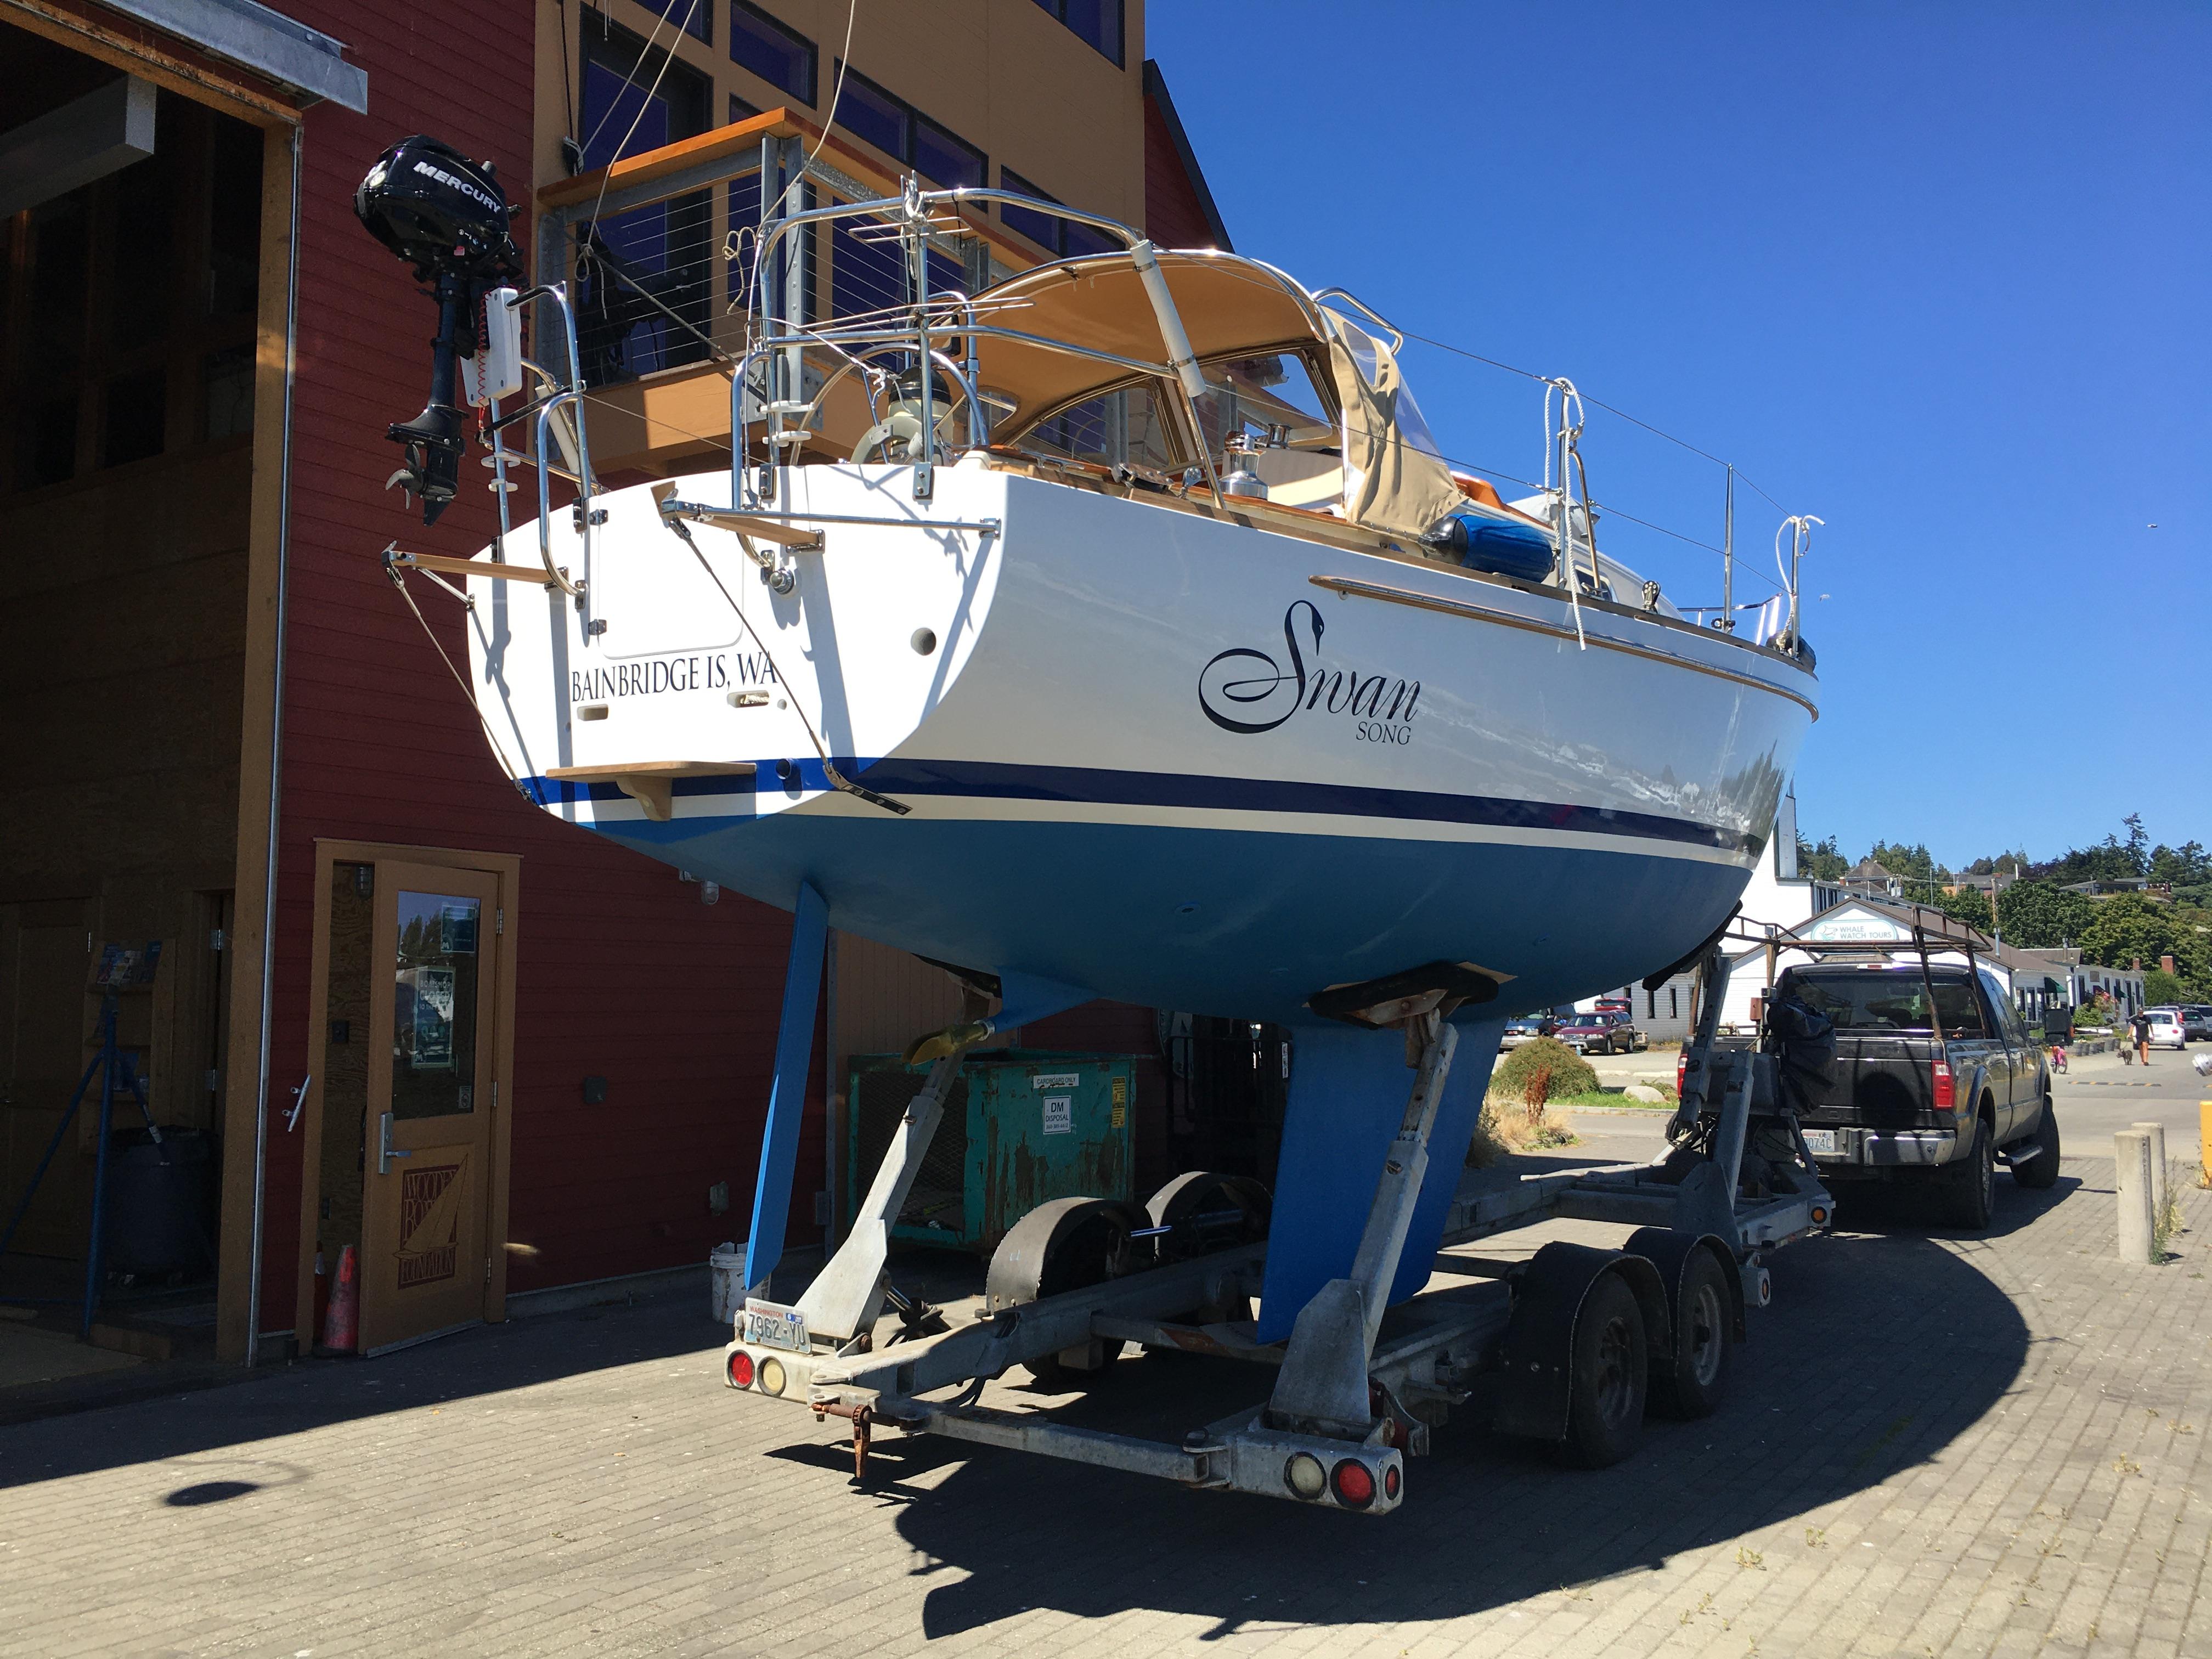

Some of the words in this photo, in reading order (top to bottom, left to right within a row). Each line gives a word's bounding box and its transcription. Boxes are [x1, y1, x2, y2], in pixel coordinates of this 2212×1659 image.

[413, 161, 500, 214] MERCURY
[572, 657, 699, 702] BAINBRIDGE
[736, 651, 778, 685] WA
[1198, 600, 1420, 733] Swan
[1356, 721, 1412, 745] SONG
[1051, 1102, 1064, 1112] DM
[749, 1306, 783, 1318] WASHINGTON
